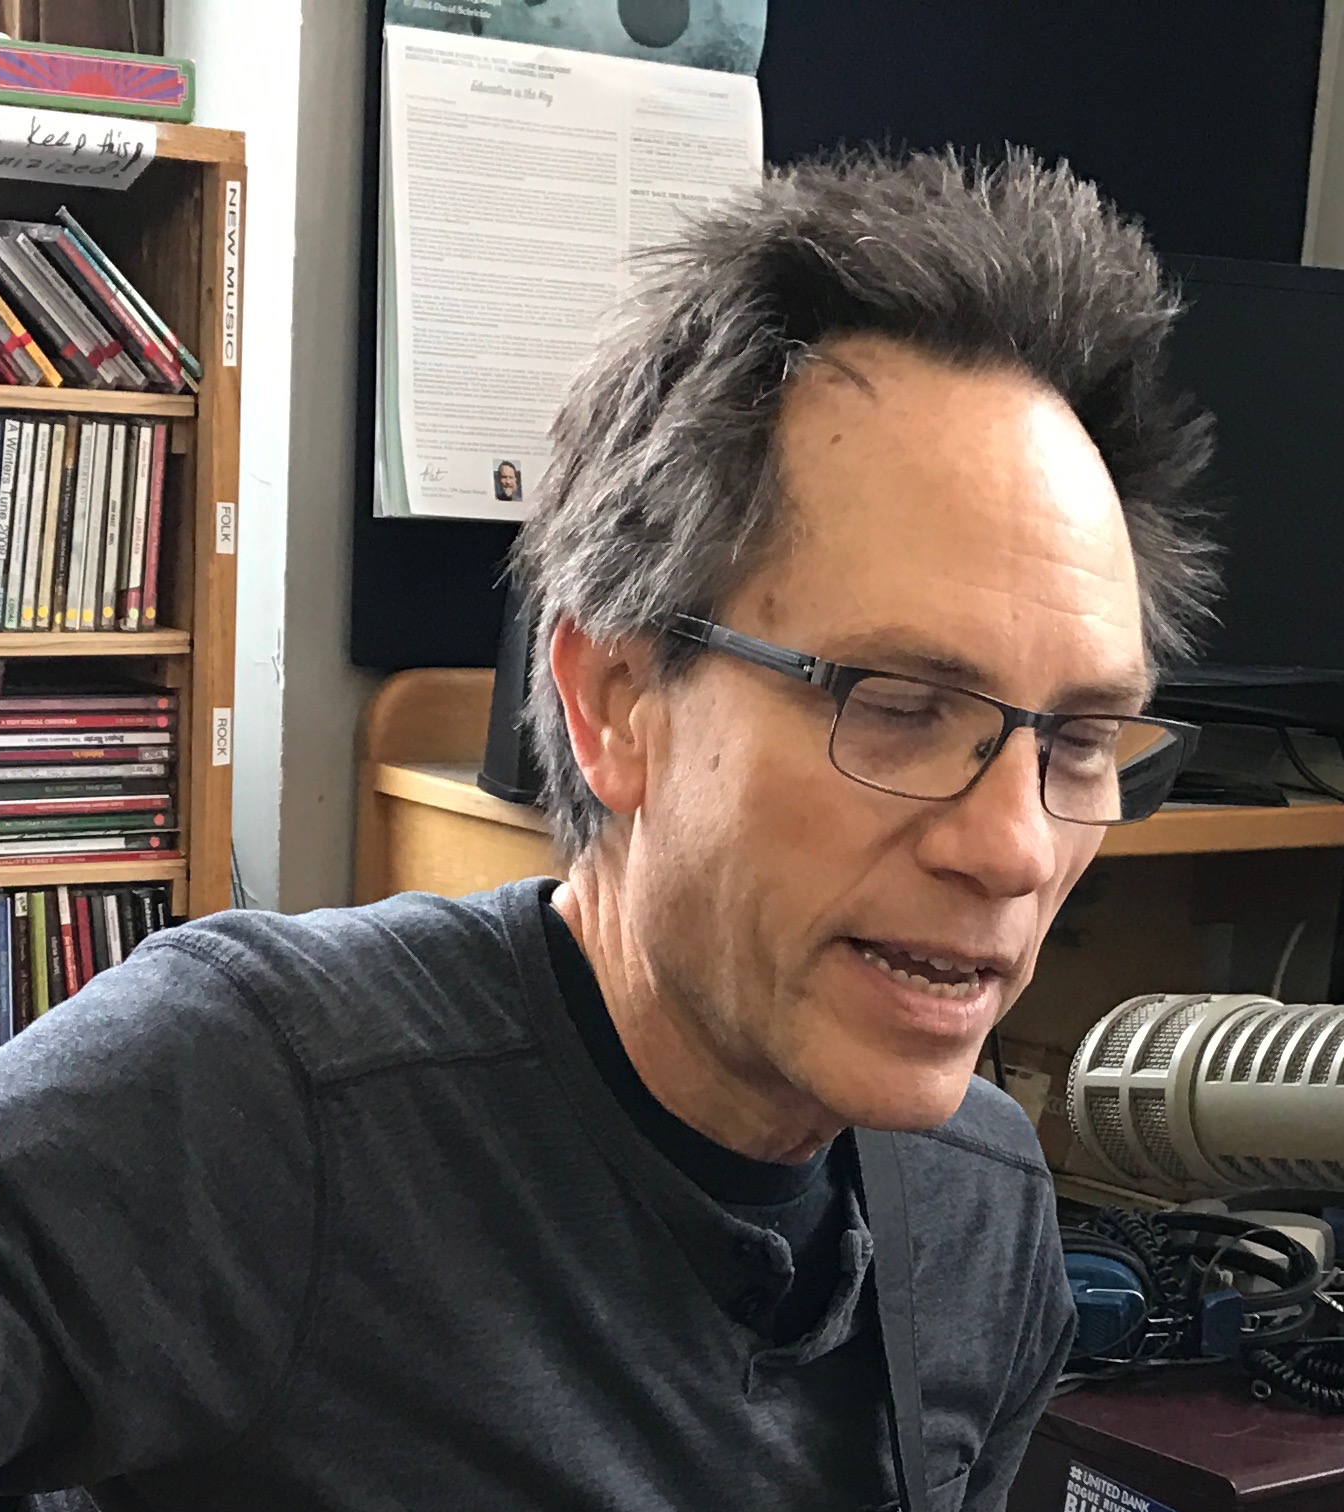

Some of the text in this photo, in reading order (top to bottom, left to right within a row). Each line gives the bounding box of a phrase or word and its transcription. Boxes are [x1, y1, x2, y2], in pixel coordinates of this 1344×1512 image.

[224, 187, 237, 360] NEW MUSIC
[8, 423, 18, 432] A
[1, 436, 17, 484] Winters
[219, 506, 232, 542] FOLK
[8, 598, 16, 624] LOCAL
[217, 718, 227, 757] ROCK
[1067, 1480, 1100, 1505] ROGUE
[1083, 1471, 1121, 1500] UNITED
